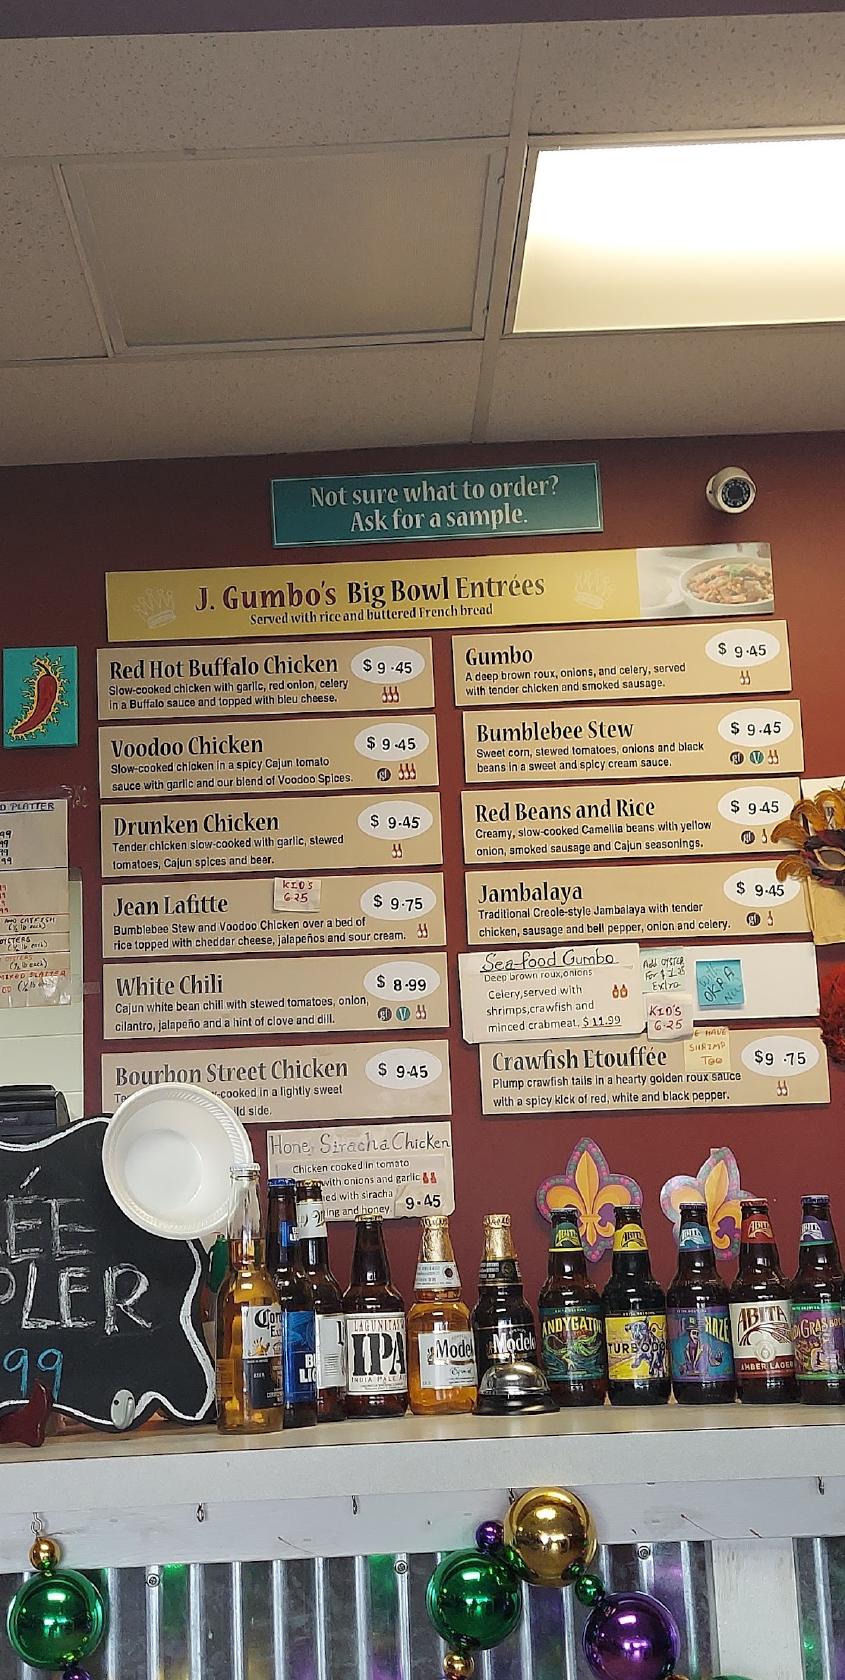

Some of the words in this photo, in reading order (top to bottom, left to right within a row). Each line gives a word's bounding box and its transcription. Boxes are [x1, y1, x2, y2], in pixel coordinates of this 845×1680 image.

[311, 487, 347, 507] Not
[352, 488, 398, 504] sure
[403, 480, 458, 502] what
[462, 481, 484, 499] to
[490, 475, 558, 498] order?
[351, 509, 388, 532] Ask
[392, 508, 425, 529] for
[430, 512, 440, 527] a
[446, 502, 527, 530] sample.
[195, 587, 214, 610] J.
[223, 580, 336, 609] Gumbo's
[347, 581, 386, 608] Big
[391, 577, 450, 601] Bowl
[457, 574, 544, 599] Entrées
[251, 612, 288, 624] Served
[291, 611, 316, 623] with
[320, 611, 340, 622] rice
[343, 609, 363, 621] and
[367, 604, 416, 620] buttered
[419, 604, 457, 617] French
[460, 603, 492, 615] bread
[466, 645, 532, 665] Gumbo
[110, 660, 144, 679] Red
[150, 661, 184, 678] Hot
[188, 657, 258, 676] Buffalo
[264, 654, 337, 674] Chicken
[109, 684, 171, 695] Slow-cooked
[174, 683, 210, 693] chicken
[213, 682, 233, 692] with
[236, 681, 266, 693] garlic,
[269, 680, 284, 690] red
[287, 679, 316, 690] onion,
[320, 678, 348, 689] celery
[466, 685, 485, 695] with
[488, 685, 519, 694] tender
[522, 683, 558, 693] chicken
[562, 681, 579, 691] and
[582, 679, 619, 690] smoked
[622, 680, 665, 689] sausage.
[477, 721, 582, 742] Bumblebee
[588, 721, 633, 738] Stew
[111, 737, 183, 757] Voodoo
[188, 735, 262, 754] Chicken
[475, 802, 509, 822] Red
[515, 803, 570, 820] Beans
[576, 798, 610, 818] and
[616, 799, 654, 816] Rice
[114, 815, 197, 836] Drunken
[204, 812, 277, 832] Chicken
[478, 882, 582, 905] Jambalaya
[113, 898, 158, 916] Jean
[164, 894, 227, 914] Lafitte
[563, 949, 614, 965] Gumbo
[116, 976, 174, 996] White
[180, 973, 222, 994] Chili
[115, 1003, 143, 1015] Cajun
[146, 1001, 173, 1012] white
[176, 1001, 199, 1011] bean
[203, 1000, 223, 1010] chili
[226, 999, 246, 1009] with
[250, 997, 284, 1008] stewed
[287, 997, 335, 1007] tomatoes,
[339, 995, 368, 1006] onion,
[486, 1002, 572, 1016] shrimps,crawfish
[575, 1000, 594, 1010] and
[488, 1020, 524, 1032] minced
[493, 1049, 578, 1071] Crawfish
[583, 1046, 666, 1068] Etouffée
[116, 1064, 200, 1087] Bourbon
[207, 1063, 266, 1082] Street
[271, 1058, 347, 1079] Chicken
[493, 1096, 513, 1106] with
[525, 1095, 552, 1108] spicy
[555, 1094, 575, 1104] kick
[578, 1094, 587, 1103] of
[591, 1093, 609, 1104] red,
[612, 1092, 638, 1102] white
[641, 1091, 659, 1102] and
[662, 1090, 689, 1101] black
[692, 1091, 729, 1102] pepper.
[392, 1131, 450, 1150] Chicken
[293, 1164, 327, 1175] Chicken
[330, 1161, 362, 1171] cooked
[376, 1160, 409, 1168] tomato
[738, 1306, 790, 1342] ABITA
[351, 1332, 405, 1376] IPA
